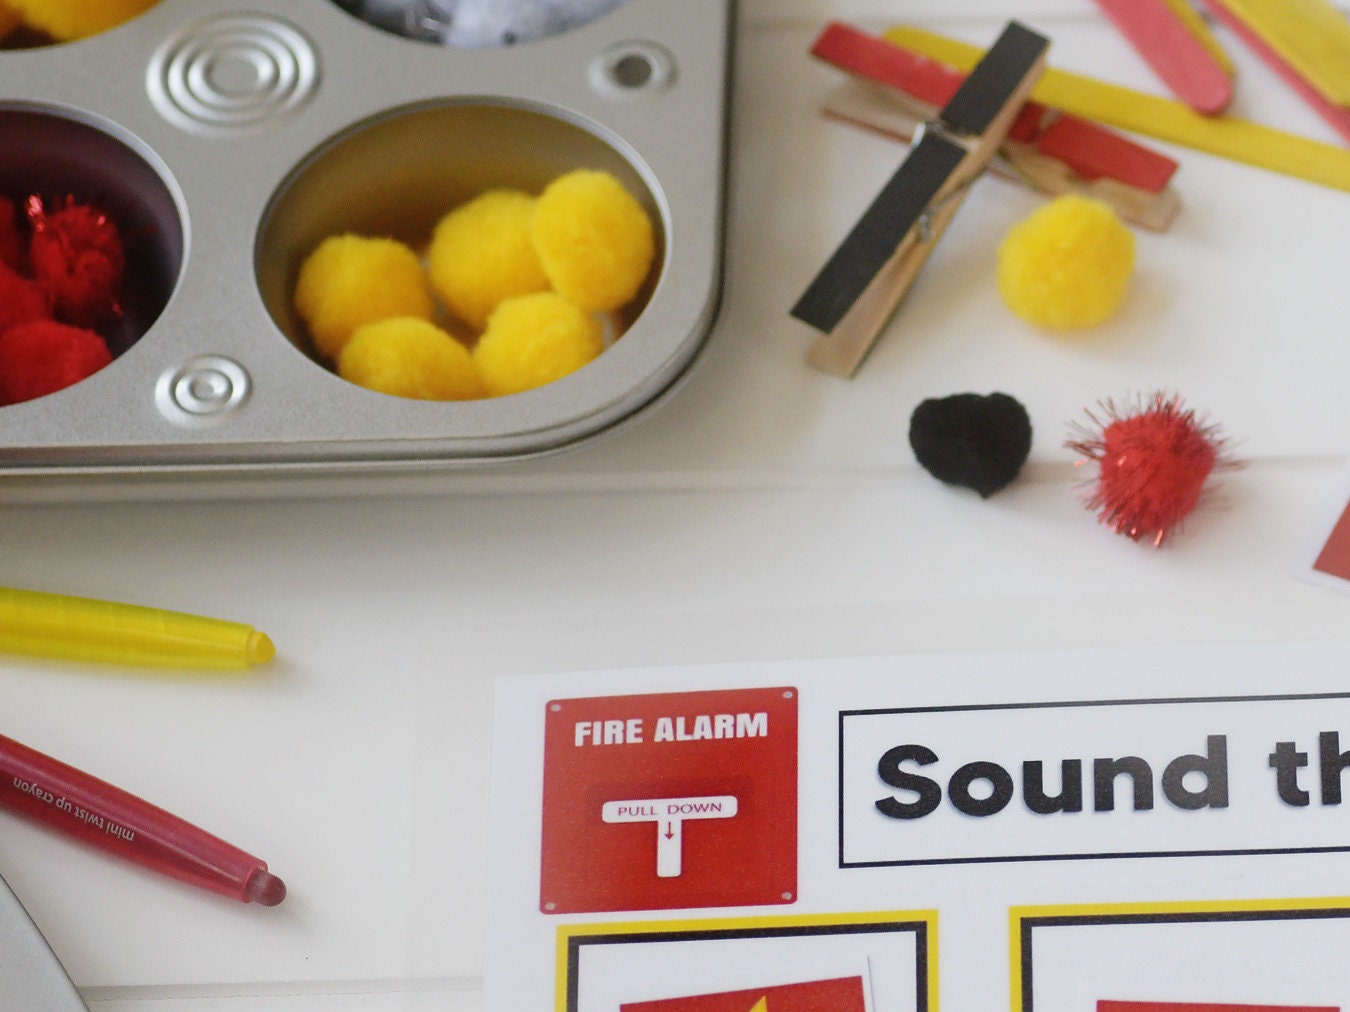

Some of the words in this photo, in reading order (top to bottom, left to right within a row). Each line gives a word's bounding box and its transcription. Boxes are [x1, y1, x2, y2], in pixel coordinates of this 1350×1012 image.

[575, 719, 643, 746] FIRE
[654, 713, 767, 742] ALARM
[875, 735, 1229, 820] Sound
[13, 777, 53, 803] crayon
[56, 797, 71, 812] up
[617, 805, 659, 818] PULL
[666, 801, 723, 816] DOWN
[74, 806, 104, 829] twist
[105, 821, 135, 841] mini
